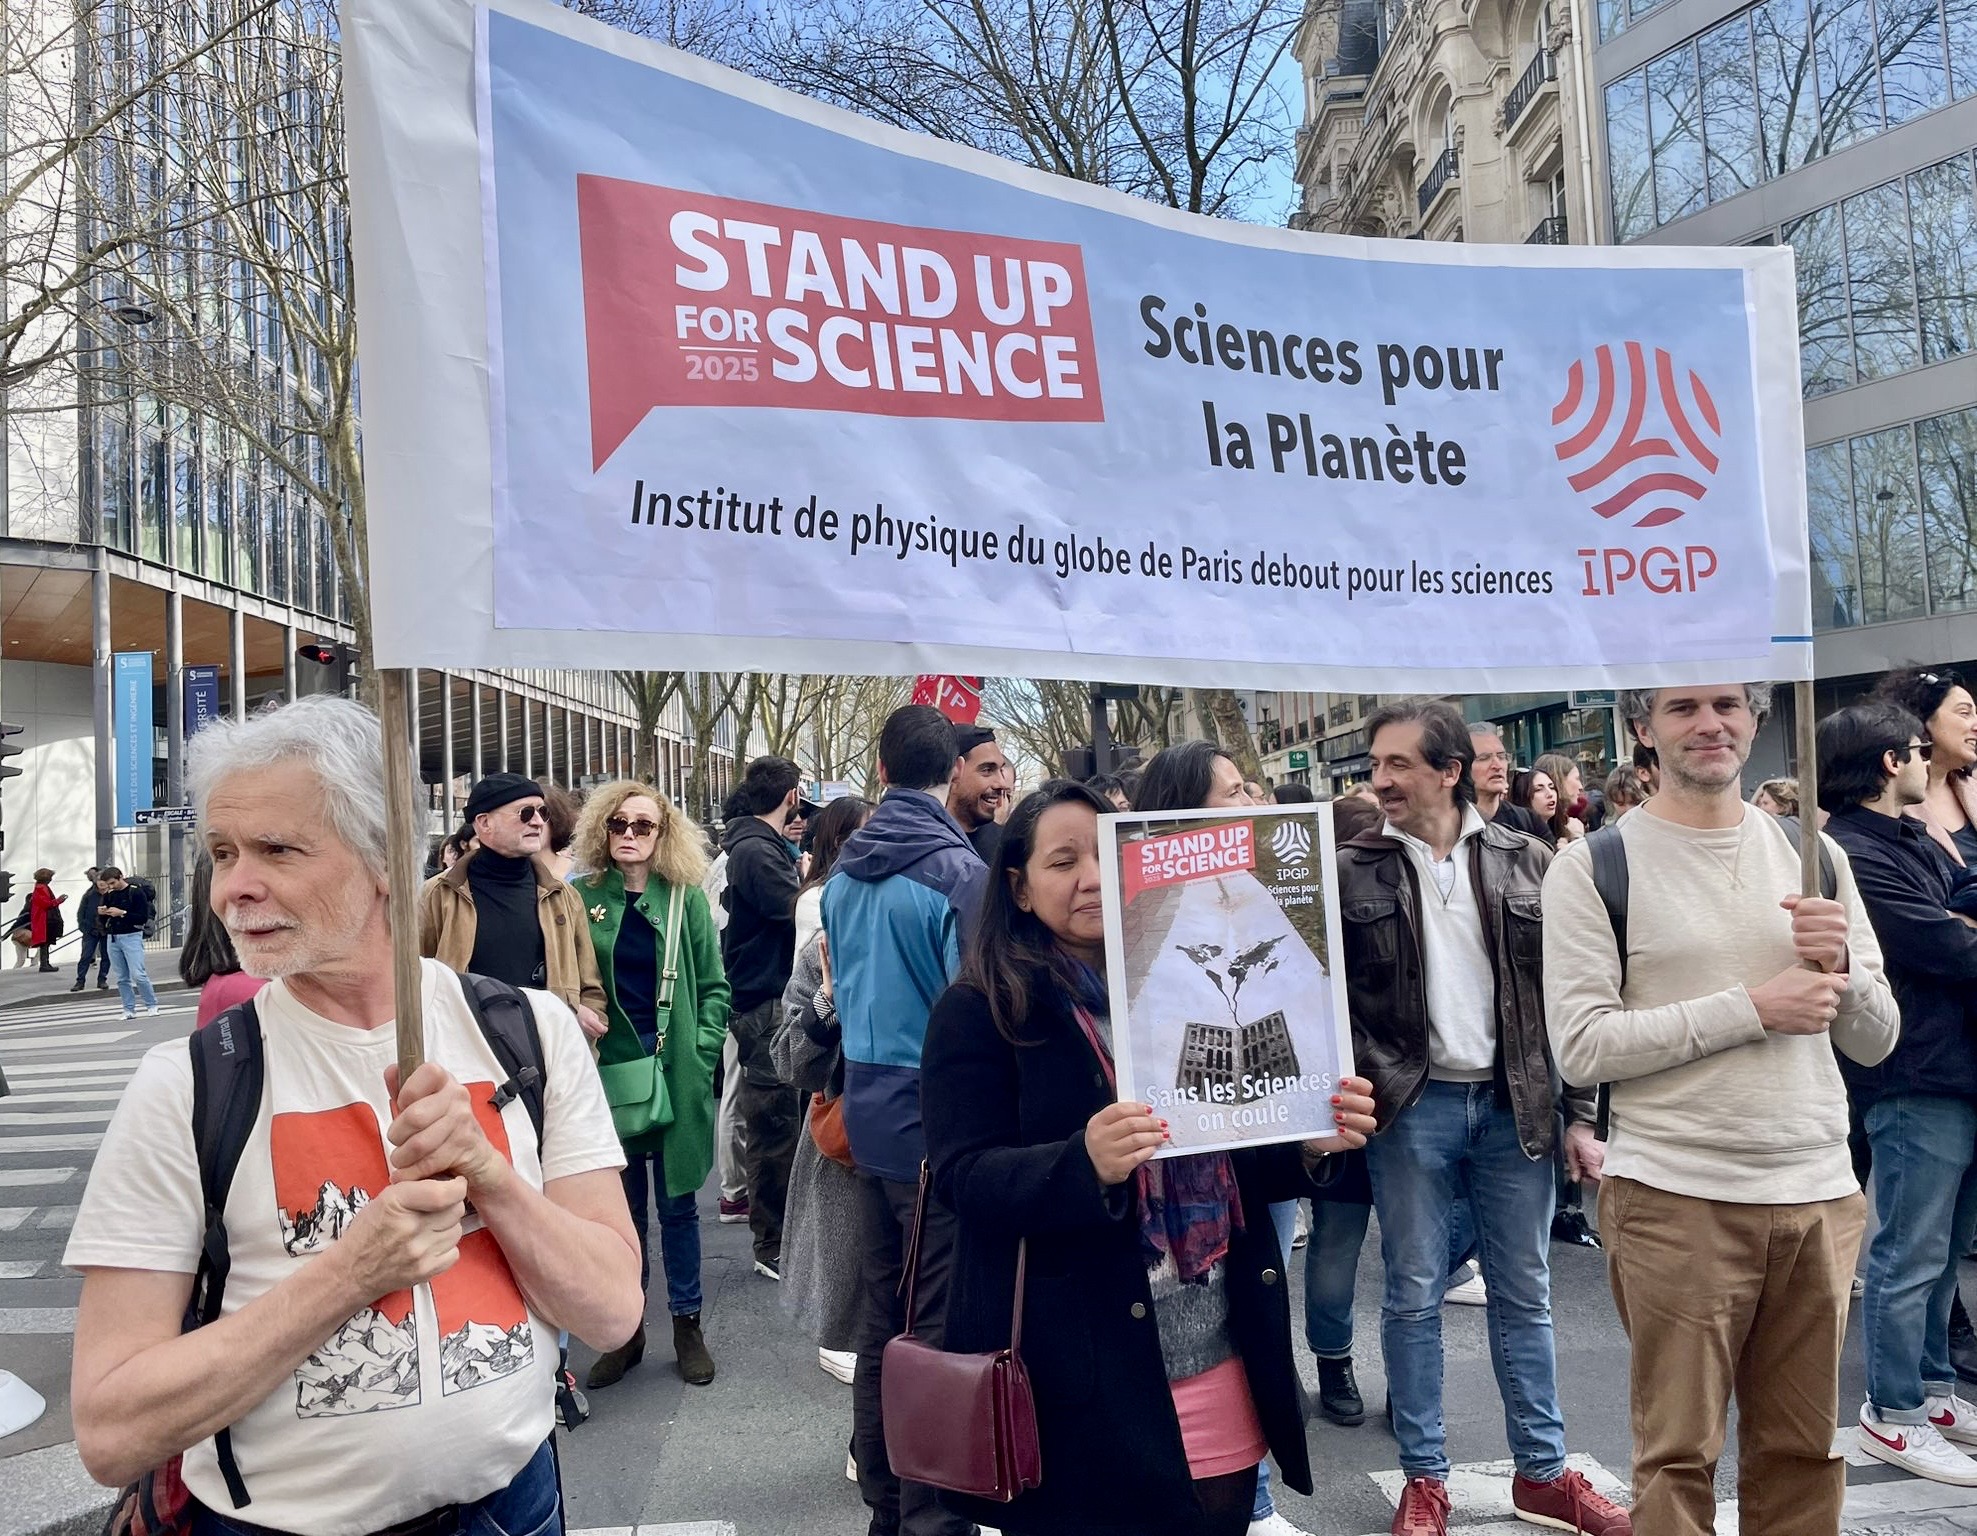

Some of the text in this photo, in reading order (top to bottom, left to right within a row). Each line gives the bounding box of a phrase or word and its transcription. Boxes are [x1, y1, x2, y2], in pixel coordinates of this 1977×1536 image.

[668, 209, 1073, 327] STAND UP
[674, 304, 1084, 399] FOR SCIENCE
[685, 354, 760, 382] 2025
[1140, 295, 1504, 405] Sciences pour
[1202, 400, 1467, 486] la Planète
[631, 479, 1553, 600] Institut de physique du globe de Paris debout pour les sciences
[1577, 545, 1718, 598] IPGP
[195, 690, 207, 731] ERSITÉ
[130, 733, 138, 771] SCIENCES
[1140, 825, 1250, 864] STAND UP
[1141, 847, 1250, 879] FOR SCIENCE
[1267, 884, 1320, 895] Sciences pour
[1276, 867, 1310, 881] IPGP
[1284, 895, 1314, 908] planète
[218, 1021, 236, 1056] Lafuma
[1145, 1071, 1332, 1109] Sans les Sciences
[1197, 1100, 1290, 1132] on coule
